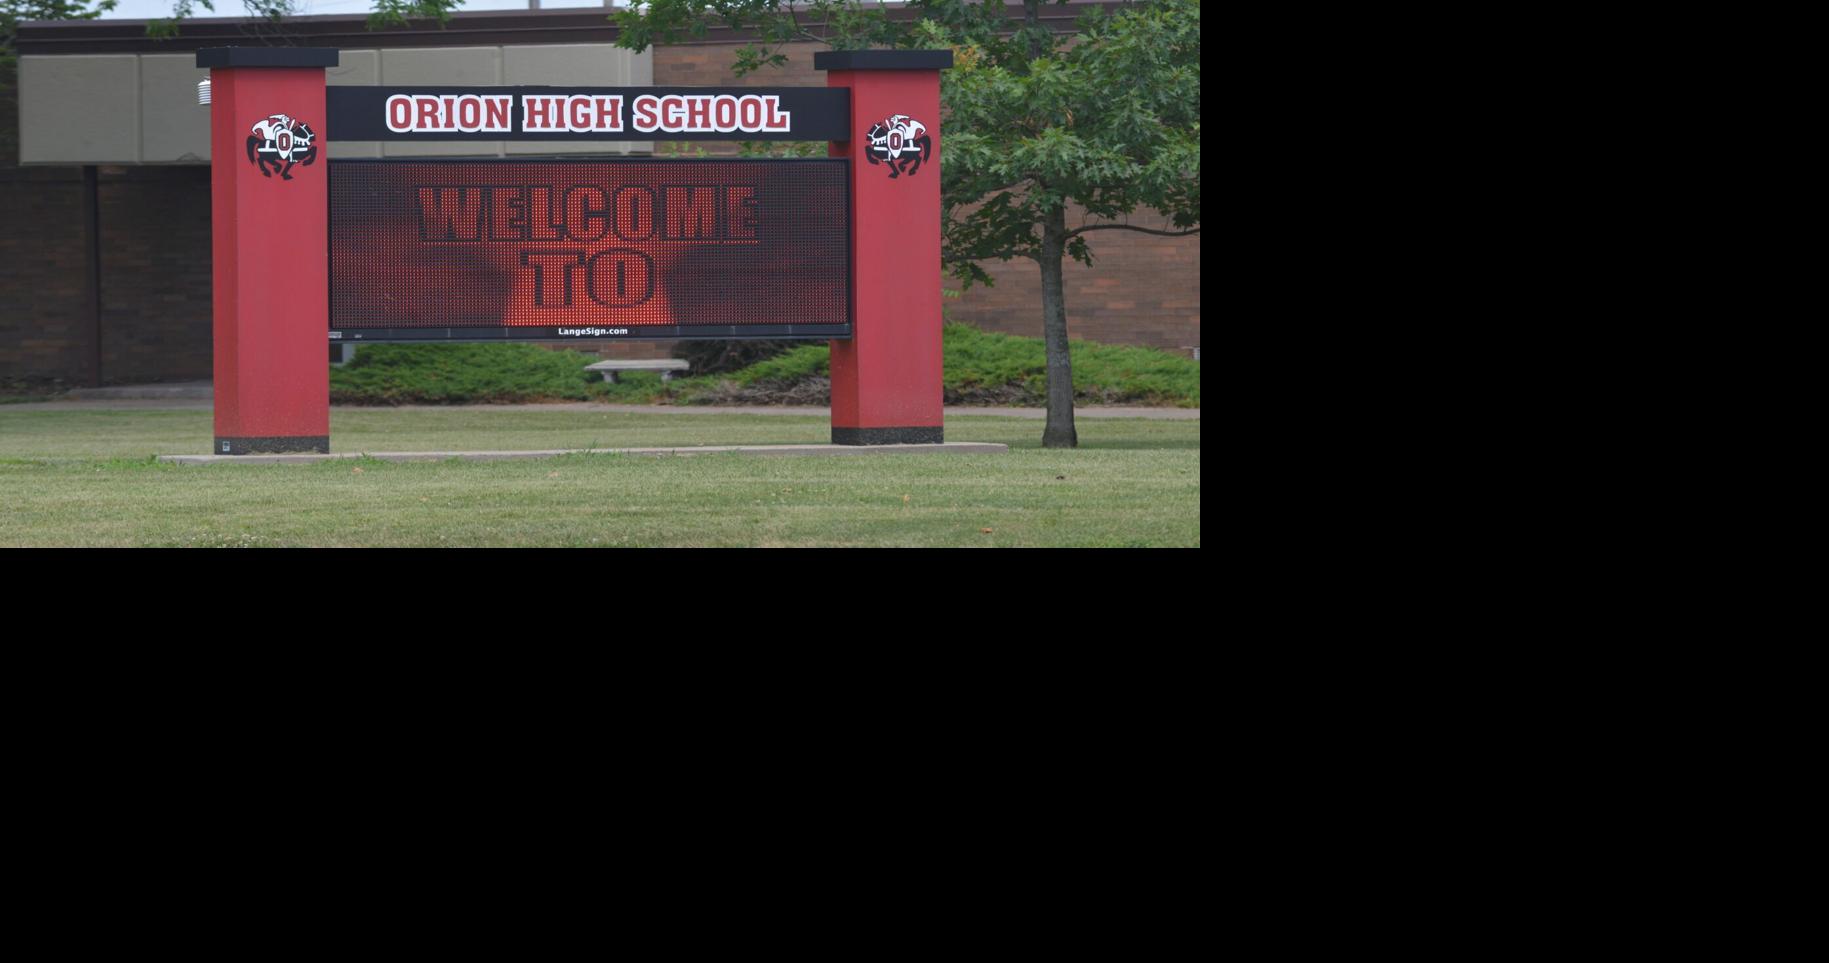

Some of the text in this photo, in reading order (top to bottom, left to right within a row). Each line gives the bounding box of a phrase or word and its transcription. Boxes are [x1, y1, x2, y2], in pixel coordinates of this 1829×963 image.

[386, 94, 790, 132] ORION HIGH SCHOOL
[278, 133, 291, 151] O
[890, 132, 902, 150] O
[417, 184, 760, 242] WELCOME
[520, 247, 656, 310] TO
[558, 327, 628, 336] LangeSign.com
